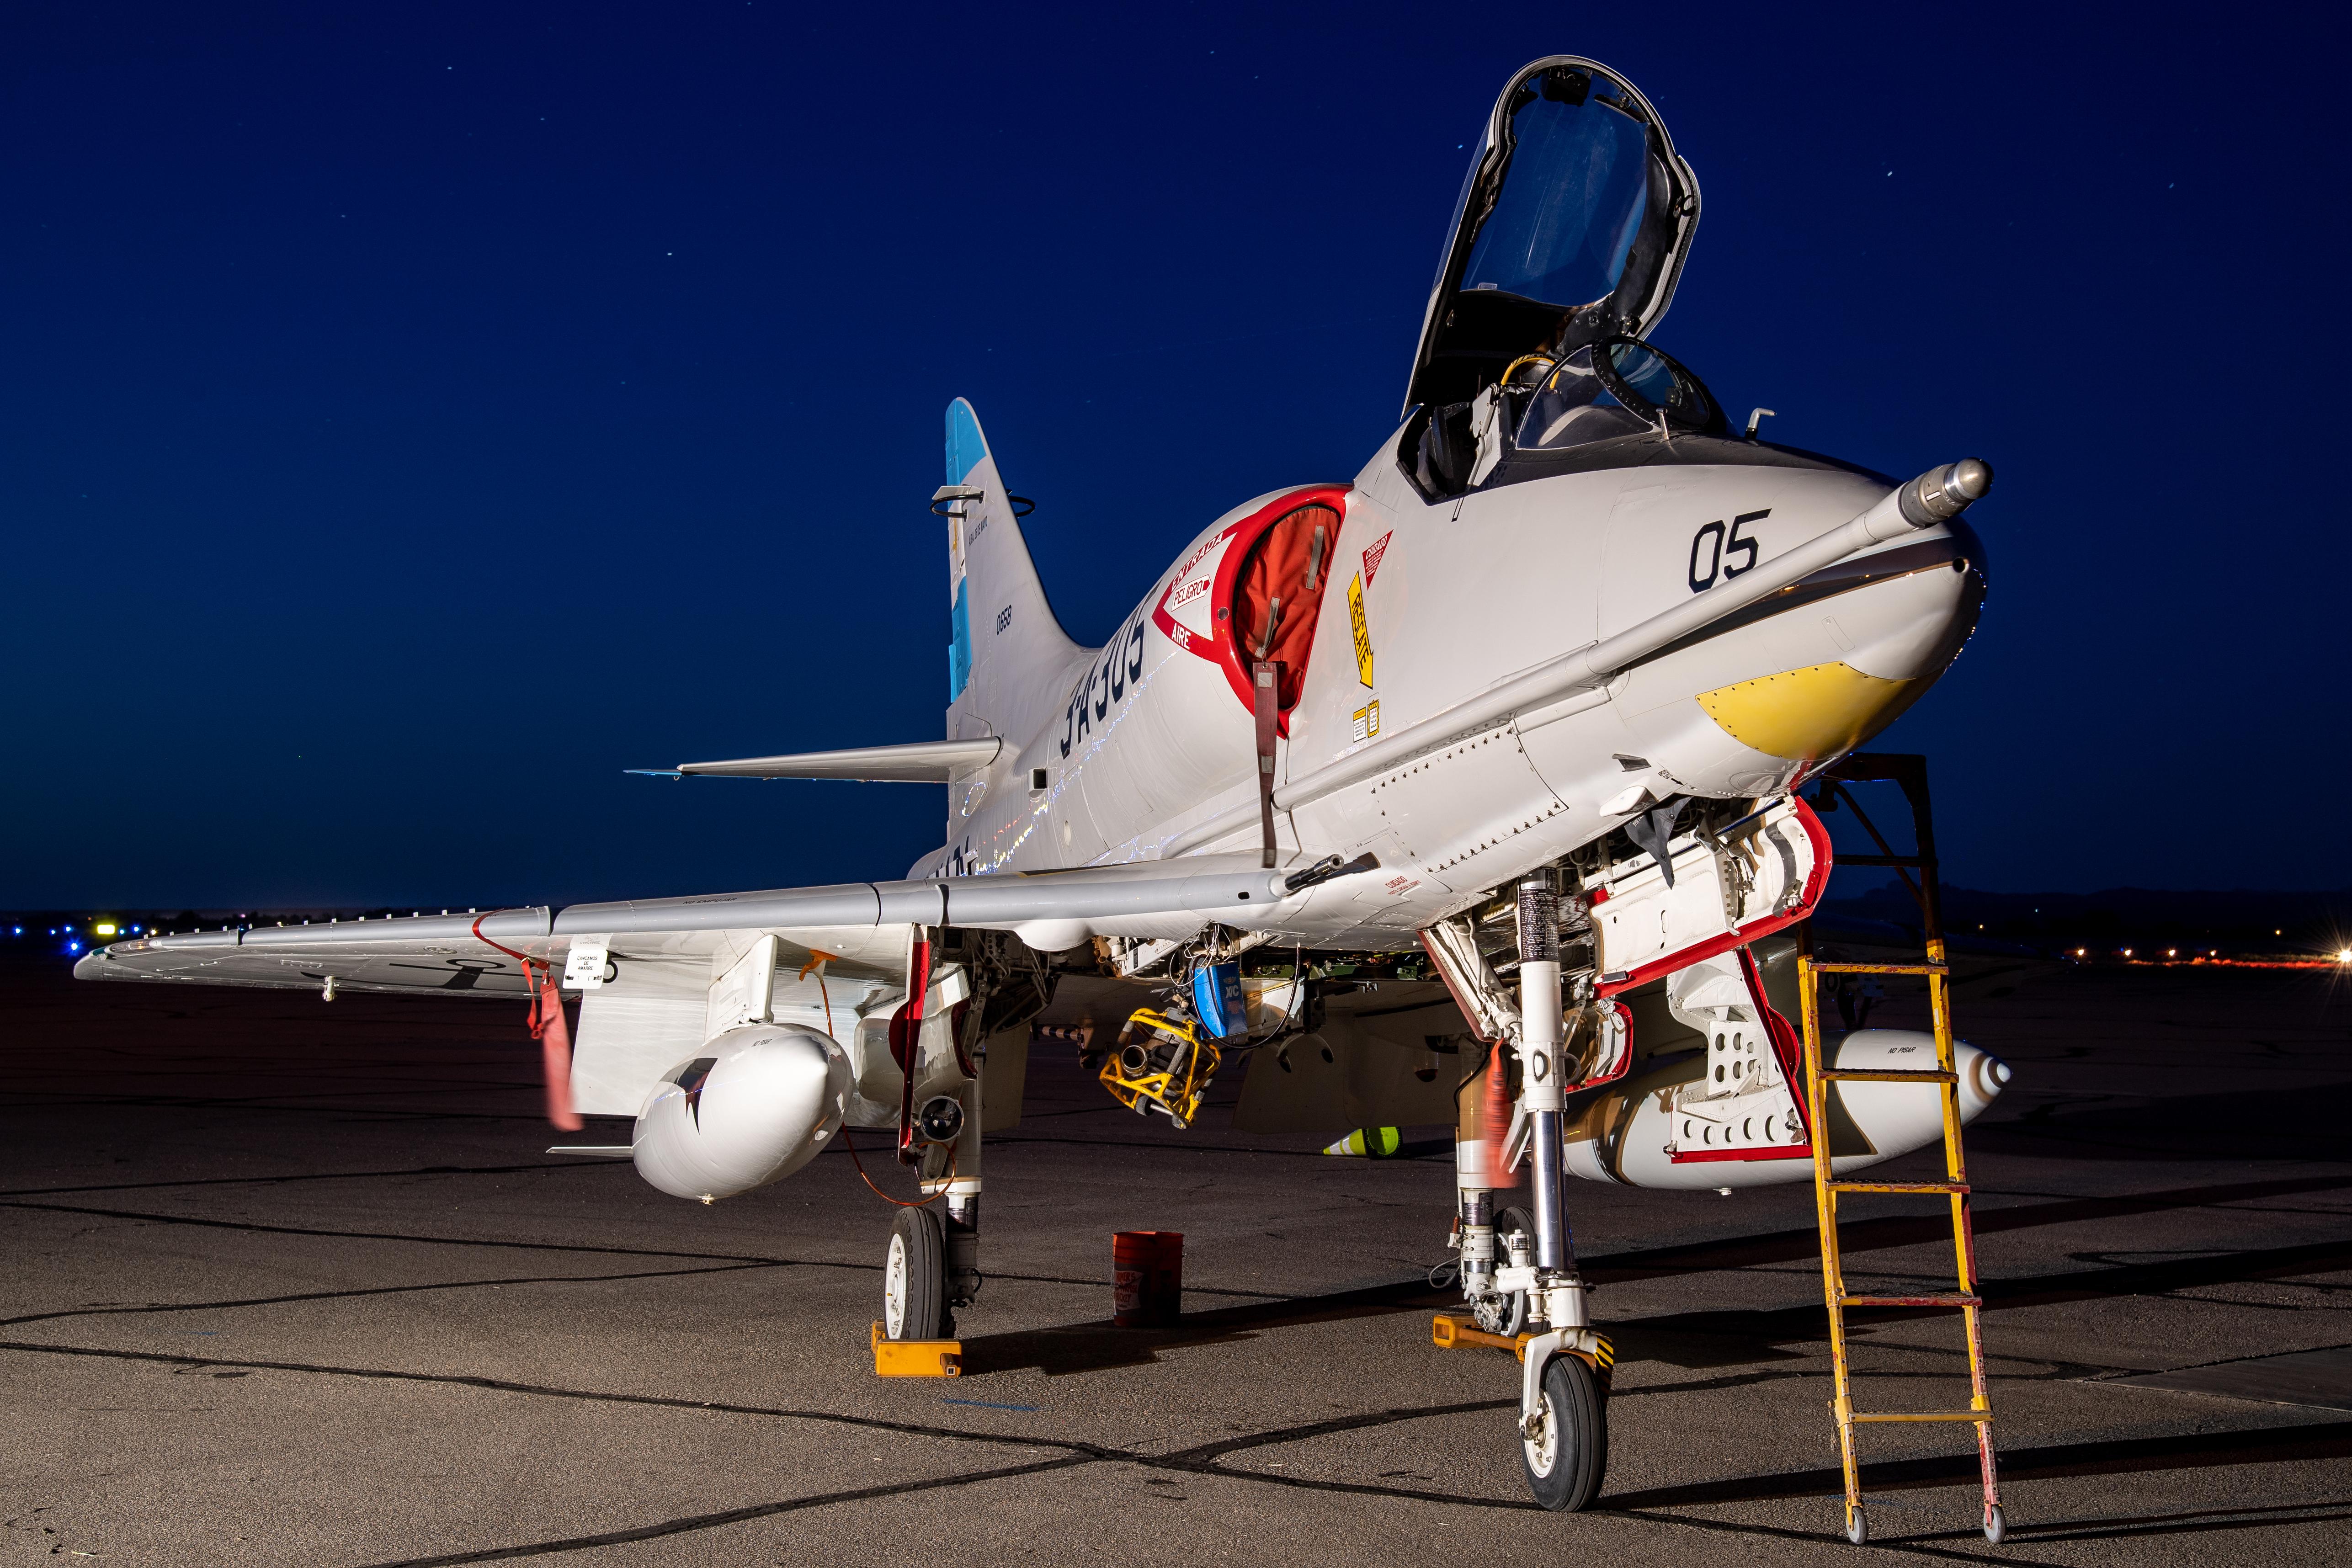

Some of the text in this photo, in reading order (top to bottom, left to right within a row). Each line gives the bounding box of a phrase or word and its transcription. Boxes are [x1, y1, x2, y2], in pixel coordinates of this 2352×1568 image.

[1171, 532, 1224, 592] ENTRADA
[1366, 535, 1388, 560] CUIDADO
[1689, 508, 1772, 594] 05
[1174, 580, 1204, 607] PELIGRO
[997, 605, 1012, 636] 0658
[1352, 592, 1369, 670] RESCATE
[1171, 622, 1191, 650] AIRE
[1385, 876, 1408, 888] CUIDADO
